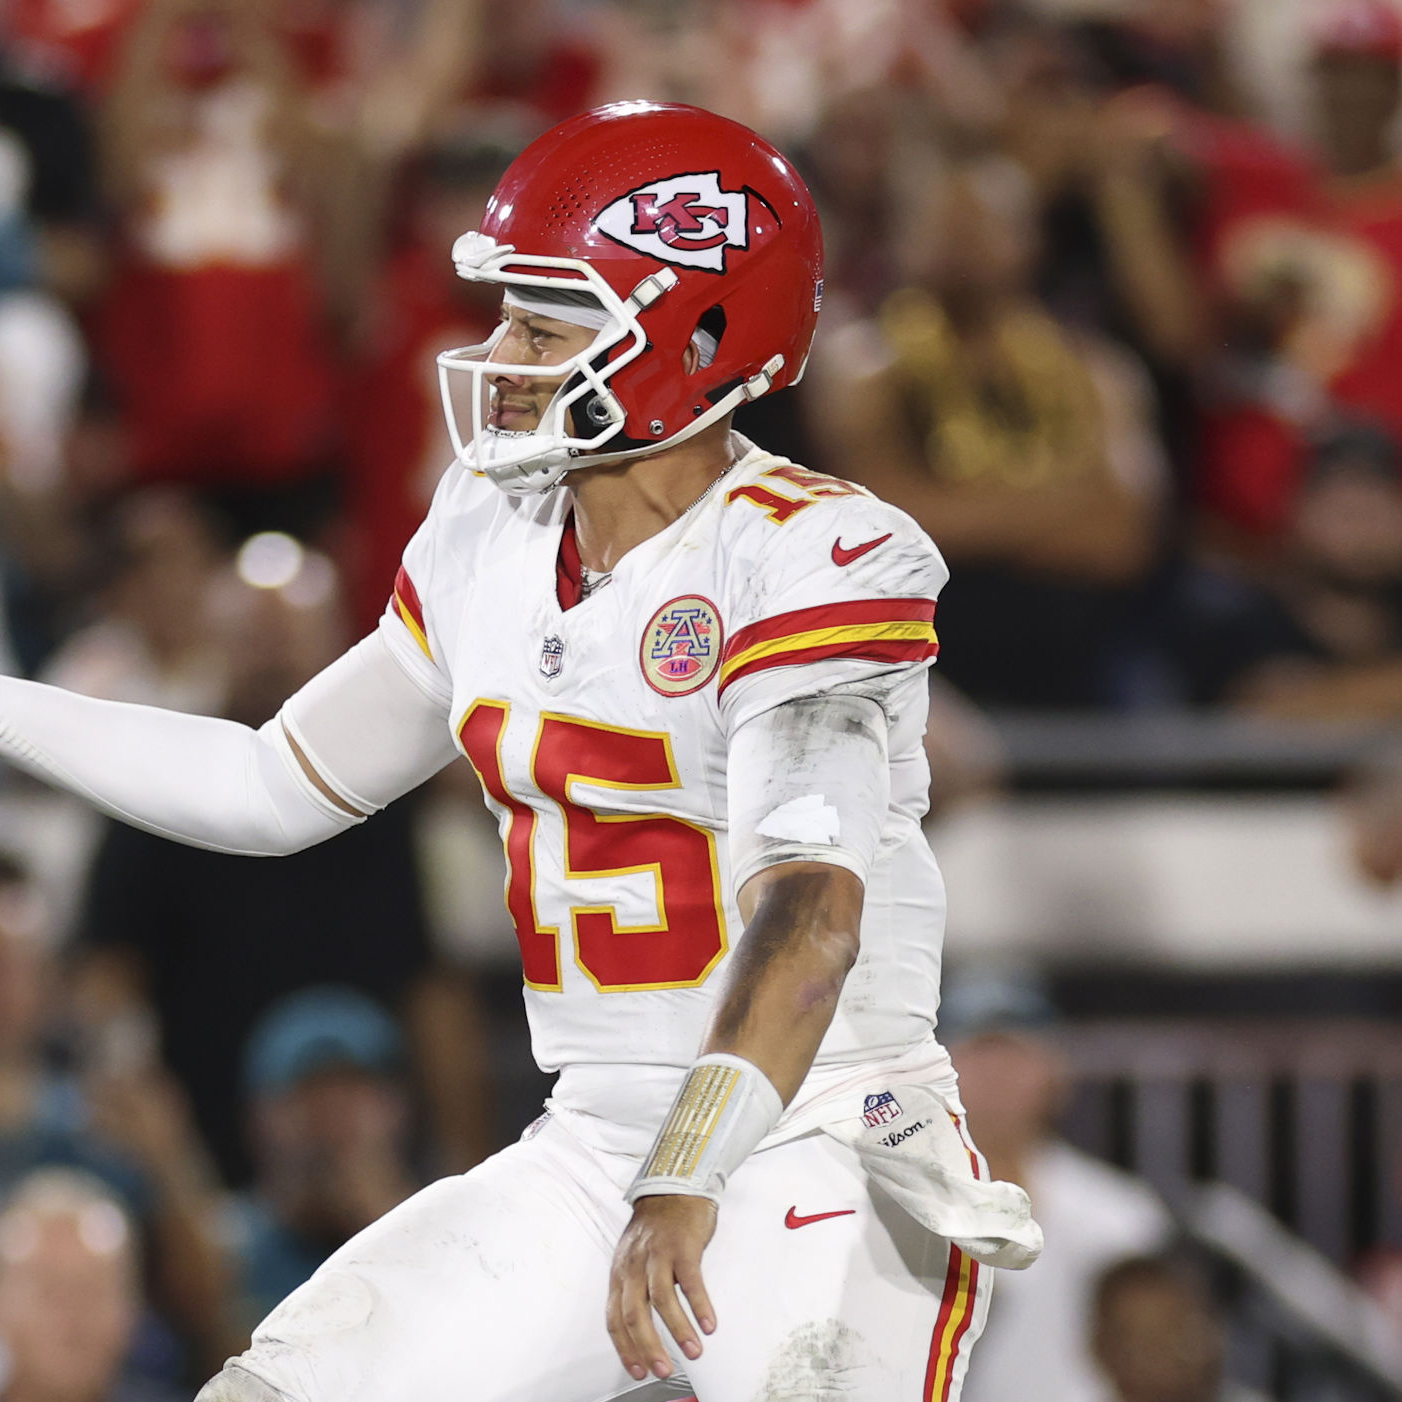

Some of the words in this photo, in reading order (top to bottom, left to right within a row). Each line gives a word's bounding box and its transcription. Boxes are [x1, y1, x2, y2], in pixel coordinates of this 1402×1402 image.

[629, 192, 728, 251] KC
[651, 608, 711, 659] A
[670, 660, 689, 674] LH
[456, 697, 730, 993] 15
[863, 1103, 900, 1128] NFL
[877, 1121, 925, 1148] ilson
